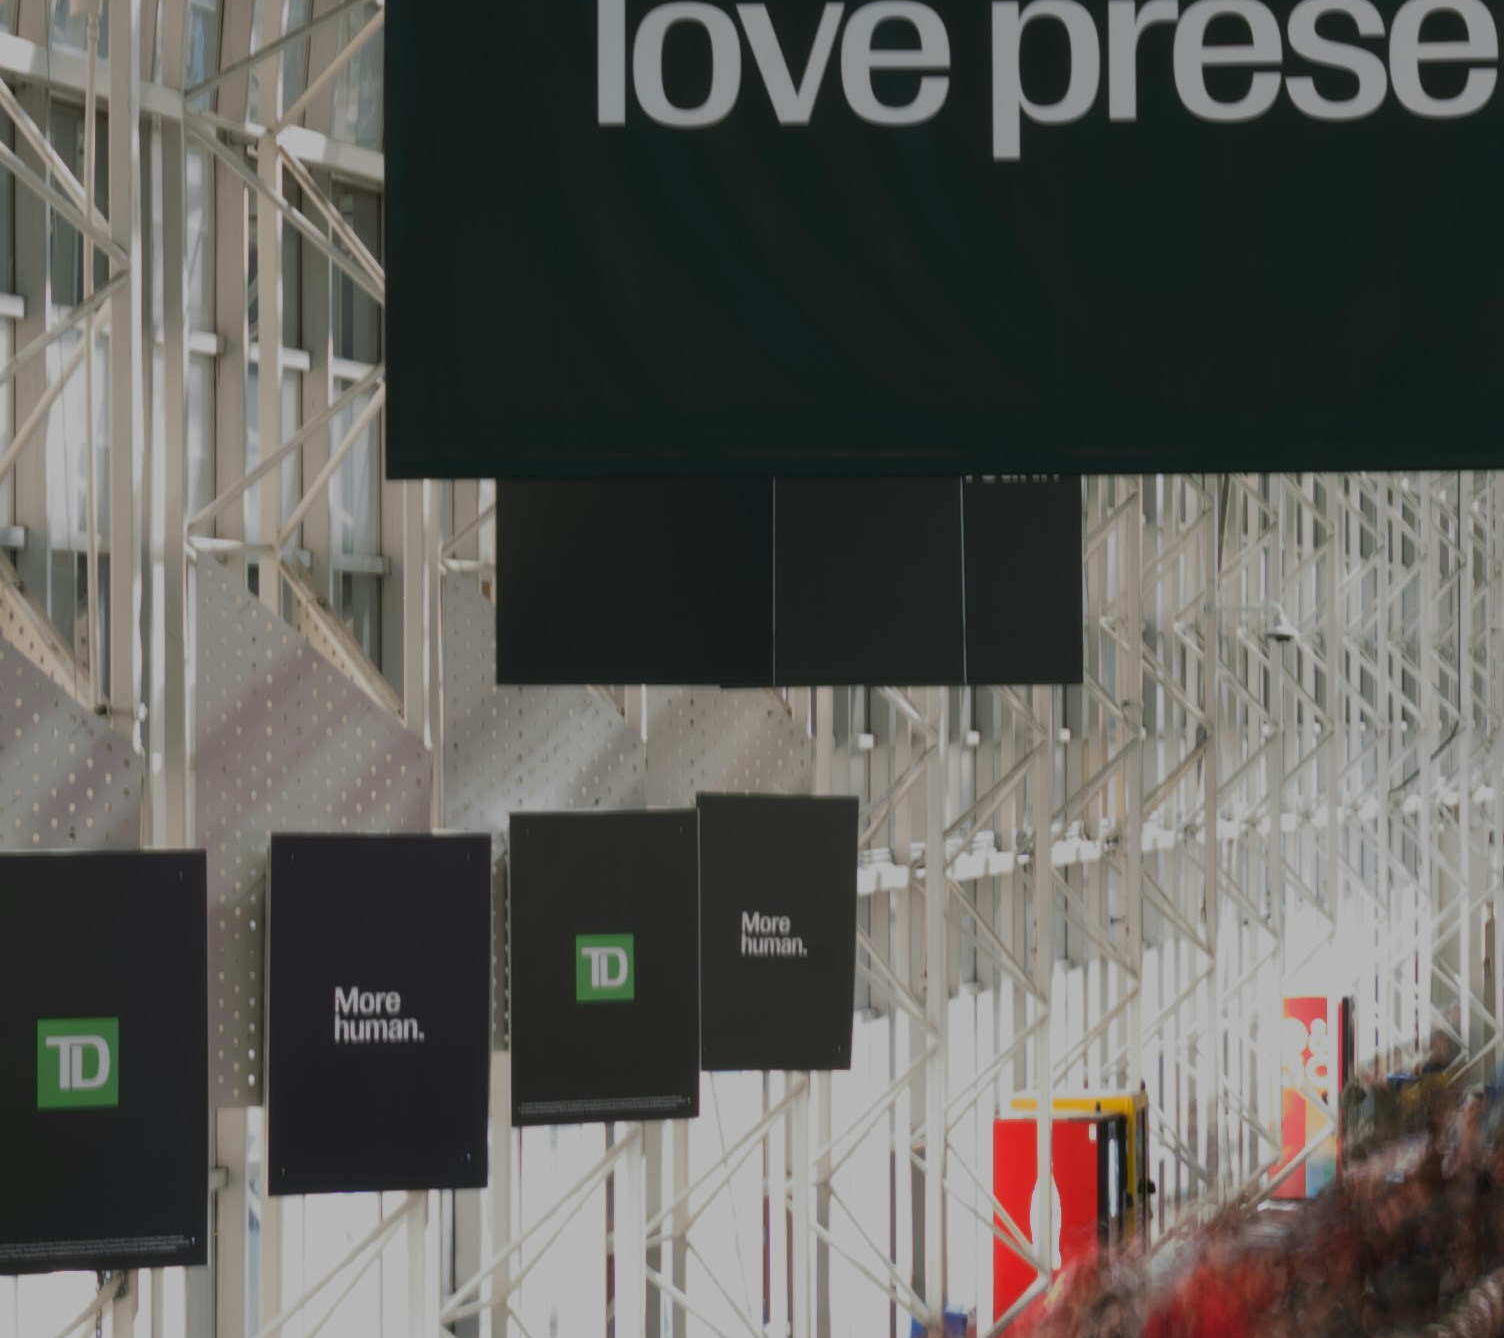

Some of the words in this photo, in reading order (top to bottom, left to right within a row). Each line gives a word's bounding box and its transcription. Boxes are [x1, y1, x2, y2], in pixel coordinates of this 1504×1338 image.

[741, 911, 791, 935] More
[741, 934, 808, 957] human.
[581, 946, 628, 989] TD
[334, 986, 401, 1014] More
[334, 1013, 425, 1042] human.
[45, 1035, 111, 1092] TD
